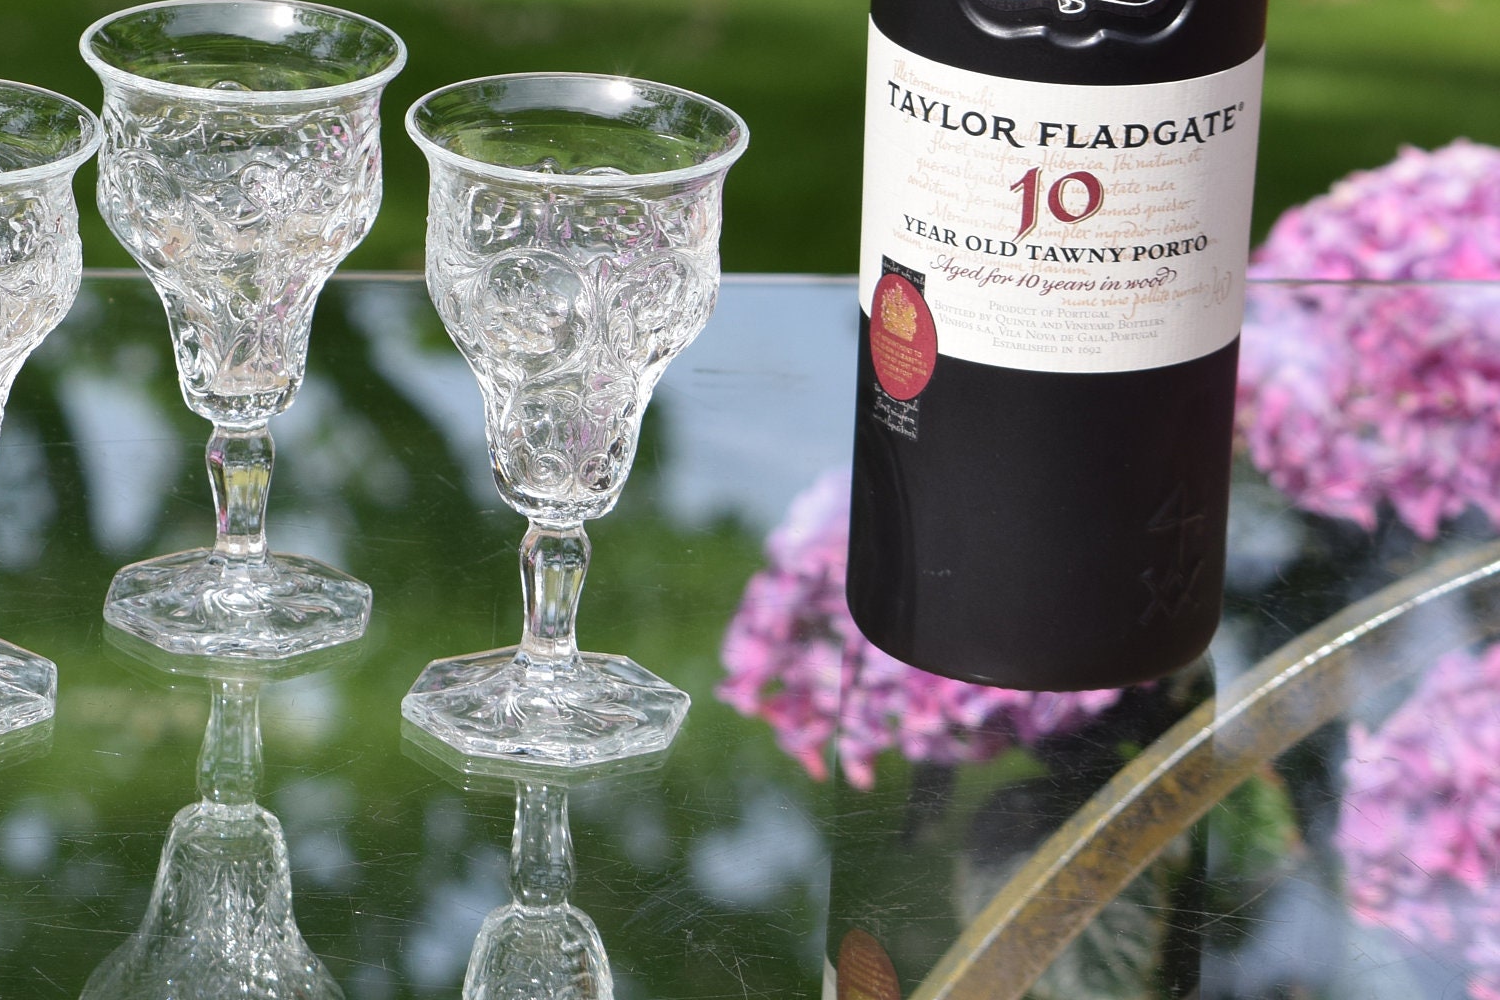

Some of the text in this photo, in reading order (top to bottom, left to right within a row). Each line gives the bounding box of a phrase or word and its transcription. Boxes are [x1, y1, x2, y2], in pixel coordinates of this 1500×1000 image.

[888, 80, 1025, 149] TAYLOR
[1010, 166, 1105, 244] 10
[904, 214, 959, 248] YEAR
[965, 235, 1018, 257] OLD
[1026, 244, 1125, 264] TAWNY
[1132, 234, 1208, 262] PORTO
[930, 252, 985, 282] Aged
[978, 267, 1014, 289] for
[1016, 272, 1040, 289] 10
[1039, 273, 1097, 296] years
[1100, 275, 1122, 291] in
[1124, 265, 1178, 288] wood
[934, 299, 1165, 331] BOTTLED BY QUINTA AND VINEYARD BOTTLERS
[938, 312, 974, 330] VINHOS
[998, 325, 1022, 338] VILA
[1025, 329, 1057, 342] NOVA
[1060, 333, 1074, 342] DE
[1110, 329, 1159, 342] PORTUGAL
[988, 300, 1110, 319] PRODUCT OF PORTUGAL
[992, 336, 1102, 355] ESTABLISHED IN 1692
